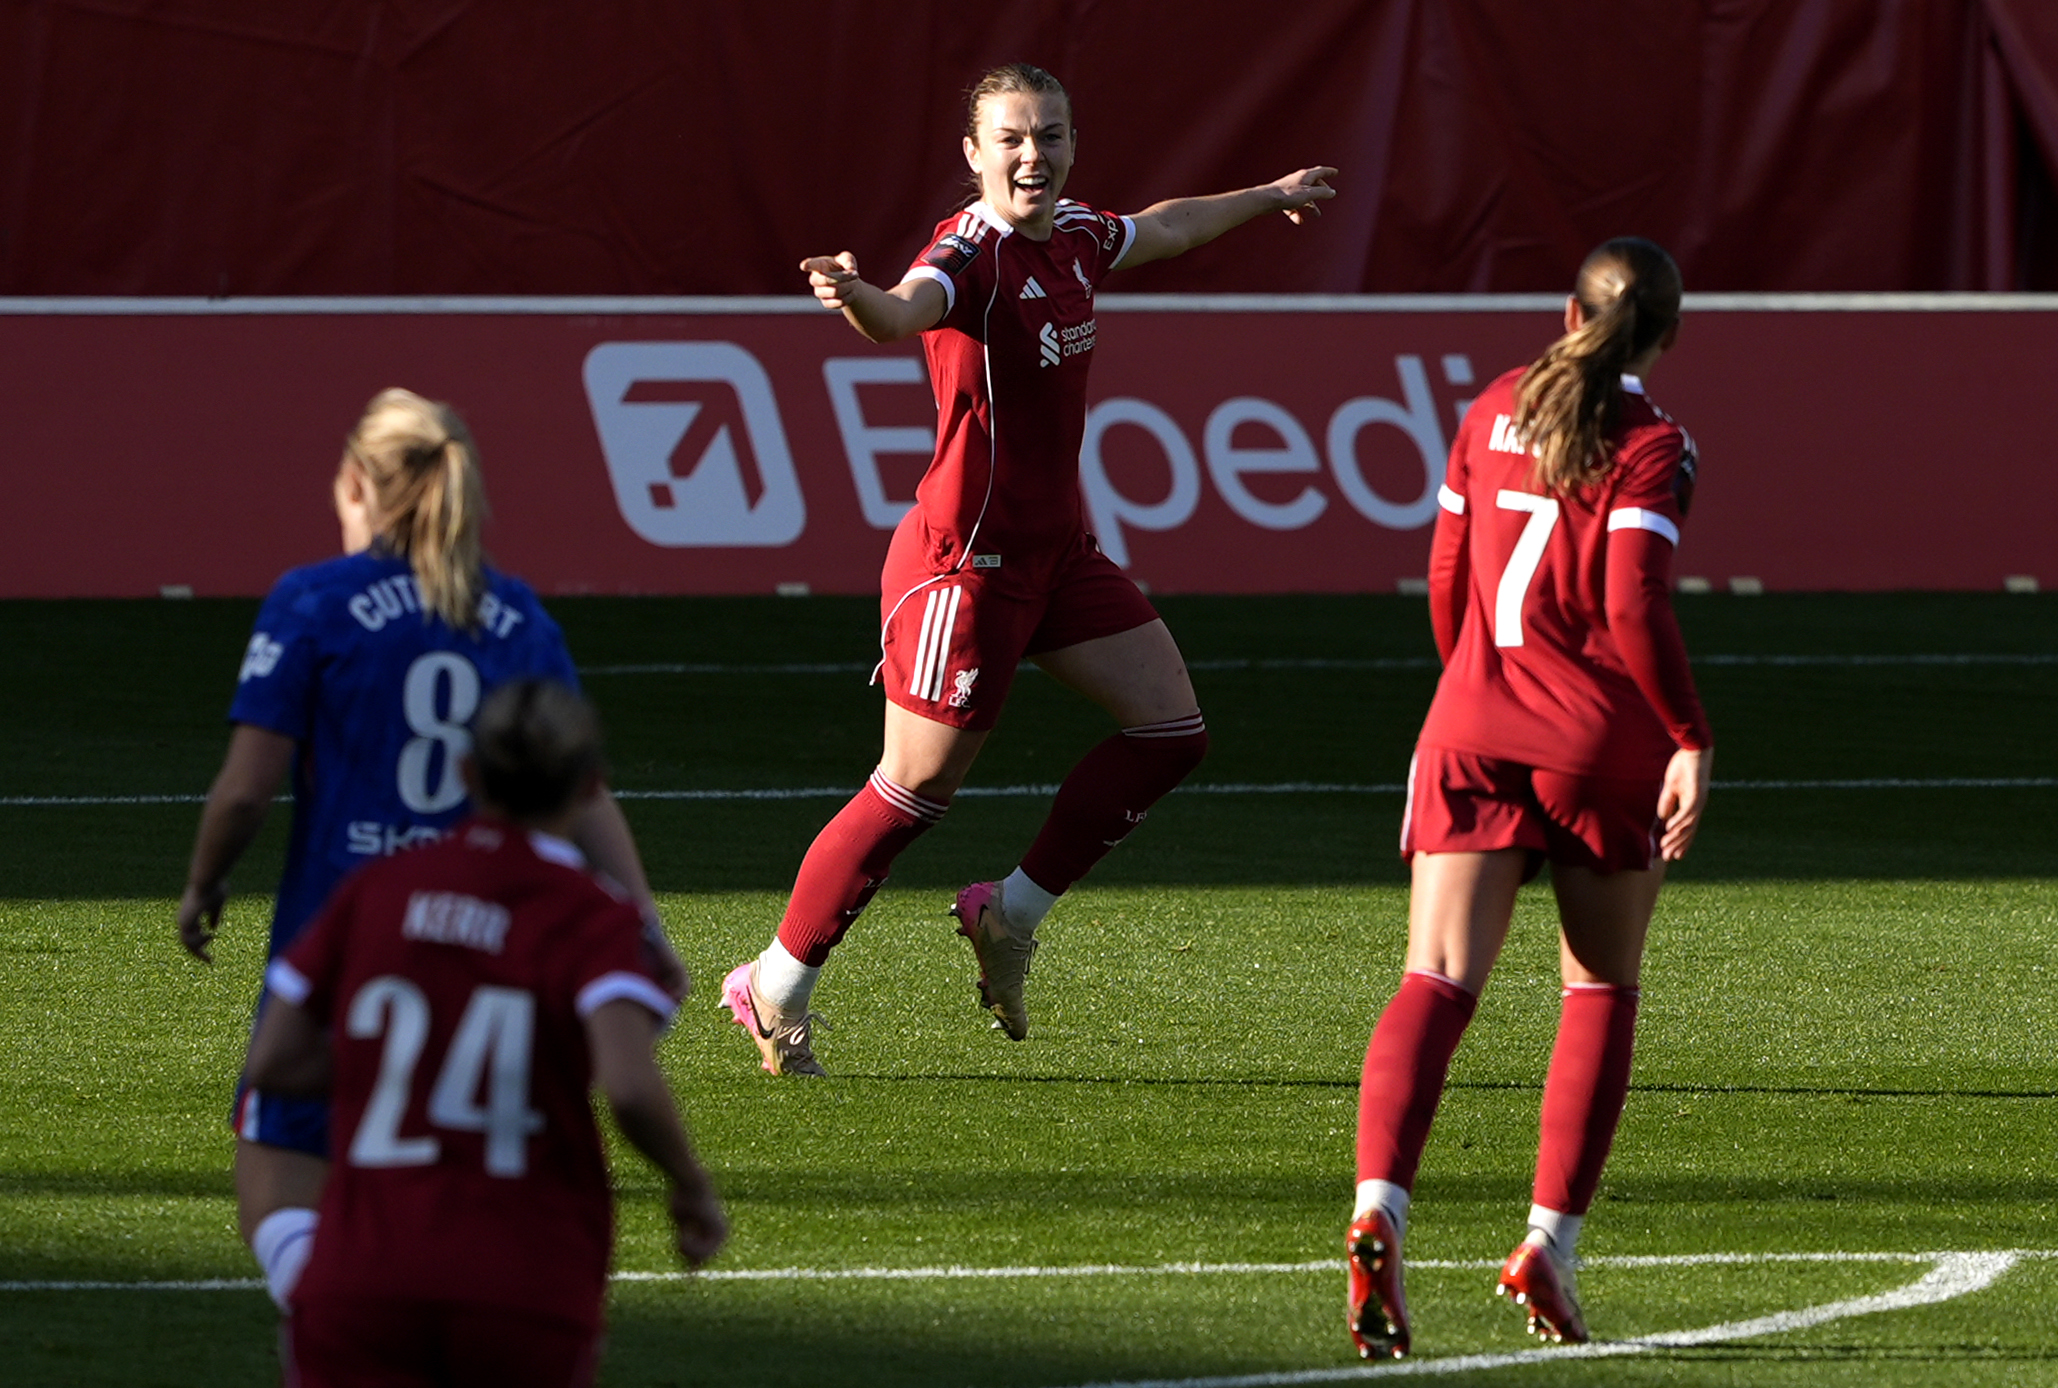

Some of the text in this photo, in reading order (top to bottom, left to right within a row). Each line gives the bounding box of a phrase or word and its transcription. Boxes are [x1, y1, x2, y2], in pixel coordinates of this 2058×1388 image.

[348, 574, 524, 640] CUTRT
[1495, 489, 1558, 647] 7
[396, 651, 481, 814] 8
[347, 975, 546, 1178] 24
